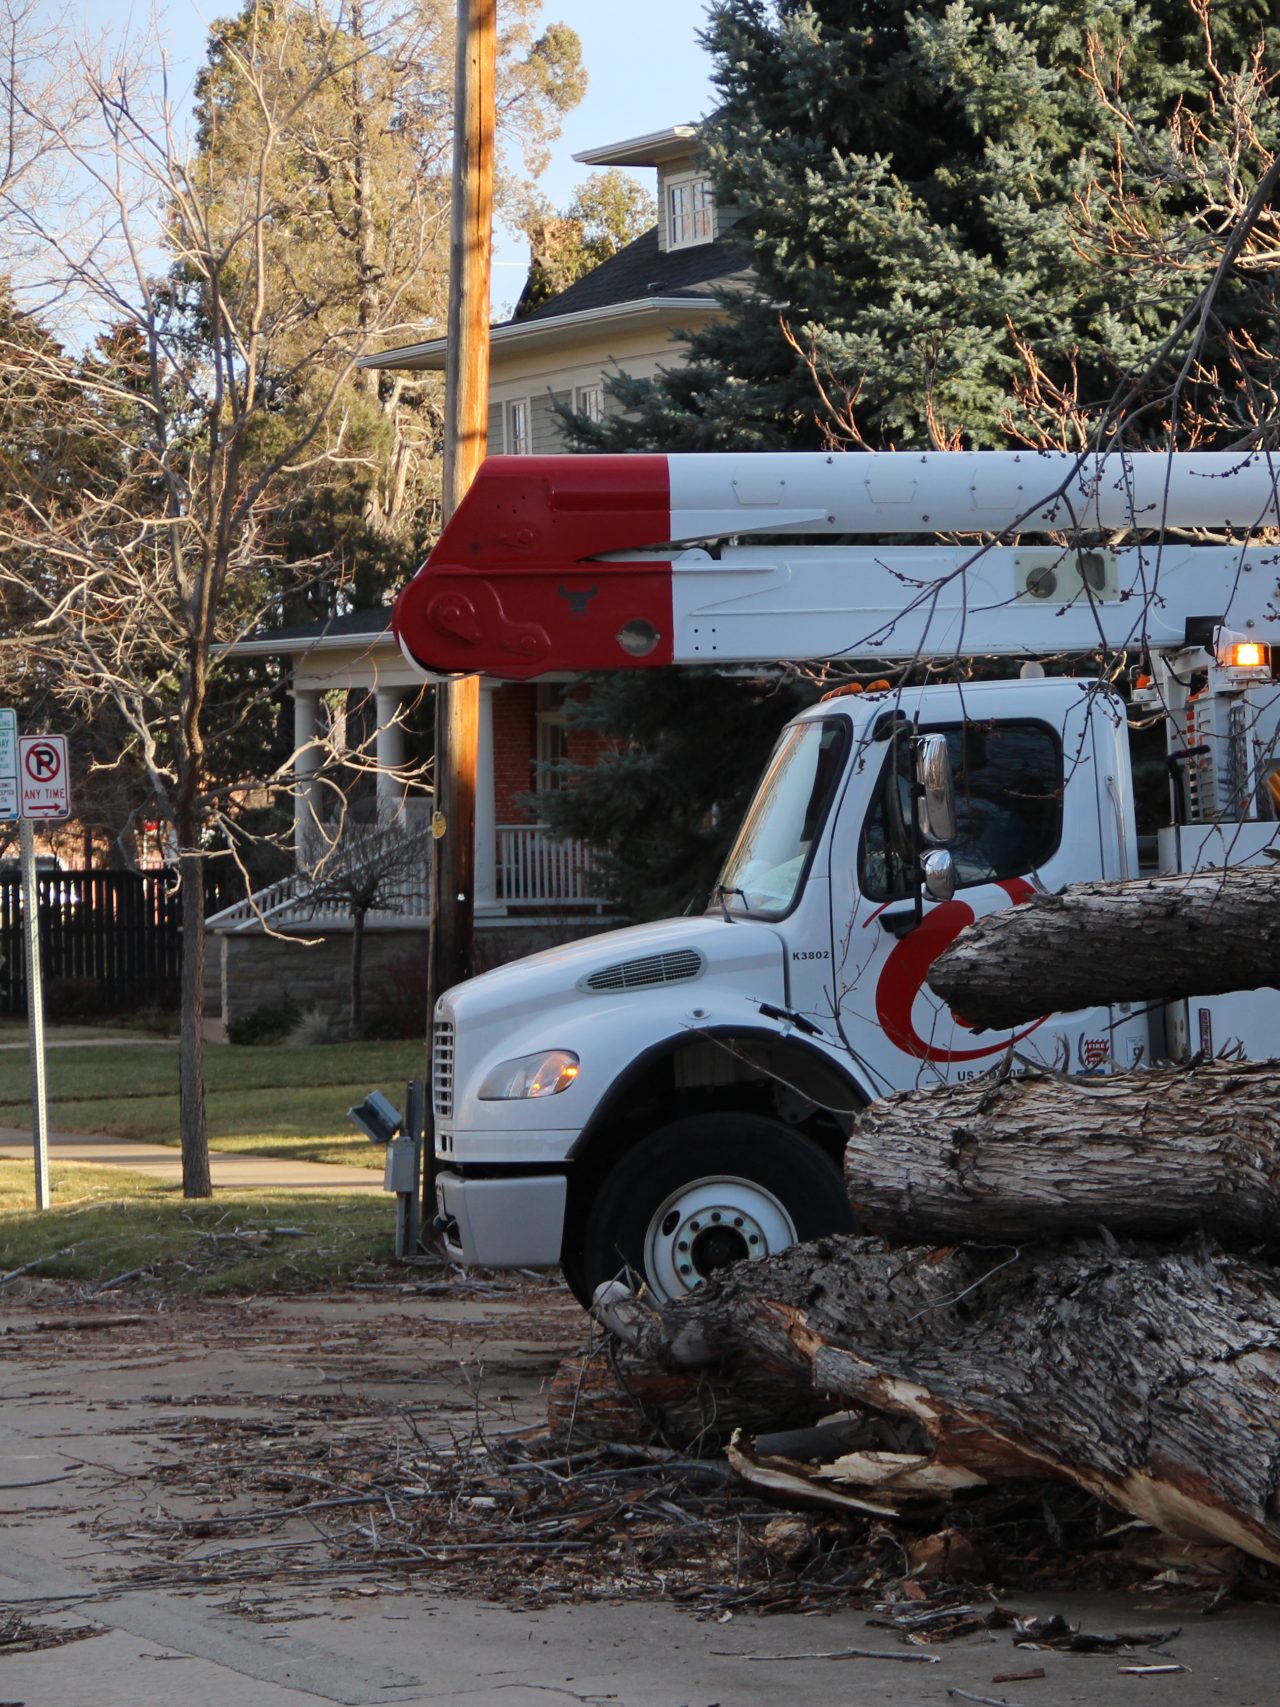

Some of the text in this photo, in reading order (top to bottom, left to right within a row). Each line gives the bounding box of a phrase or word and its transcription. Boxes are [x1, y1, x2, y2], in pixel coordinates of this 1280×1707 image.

[24, 788, 65, 800] ANY TIME
[792, 950, 830, 961] K3802
[957, 1070, 974, 1081] US
